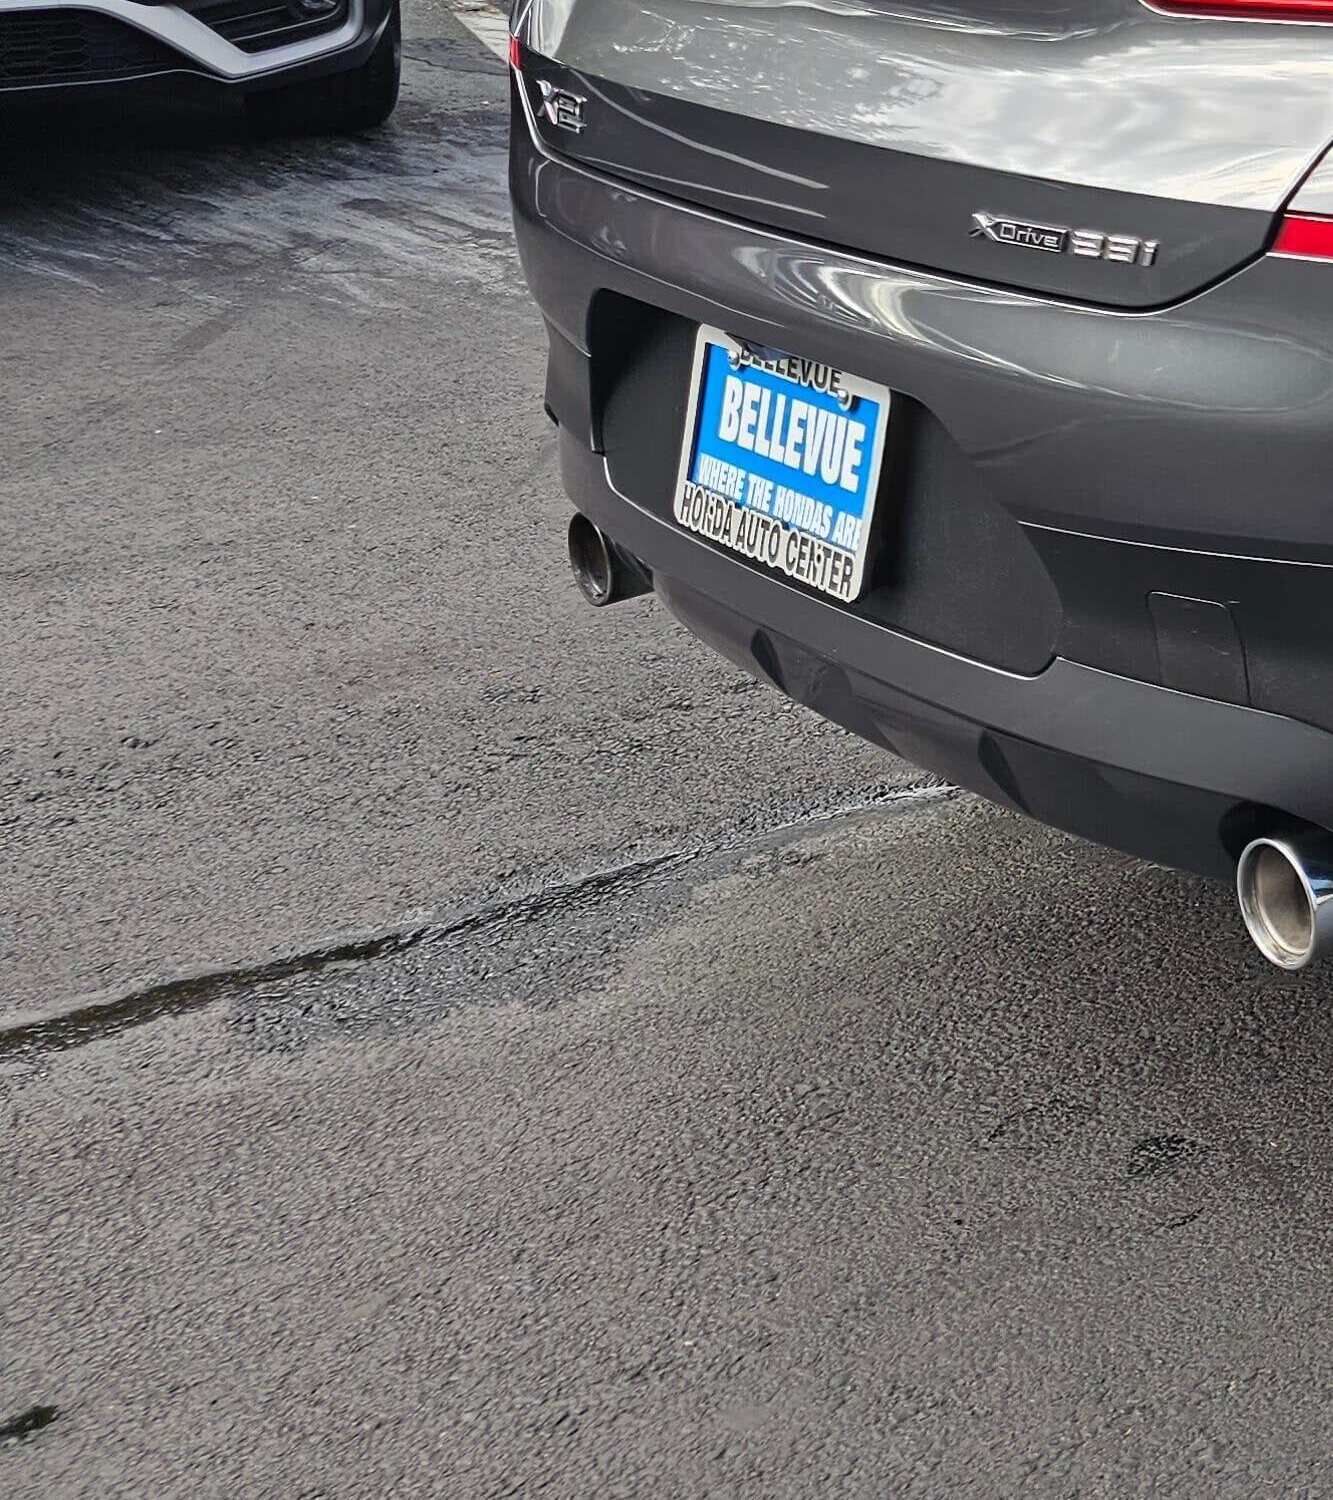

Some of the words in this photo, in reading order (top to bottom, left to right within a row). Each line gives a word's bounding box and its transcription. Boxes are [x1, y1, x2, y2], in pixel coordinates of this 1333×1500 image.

[535, 79, 588, 134] X2
[718, 374, 866, 493] BELLEVUE
[680, 485, 733, 544] HONDA
[735, 509, 781, 563] AUTO
[786, 531, 854, 598] CENTER
[698, 452, 746, 501] WHERE
[746, 473, 774, 512] THE
[773, 485, 832, 538] HONDAS
[832, 511, 862, 550] ARE
